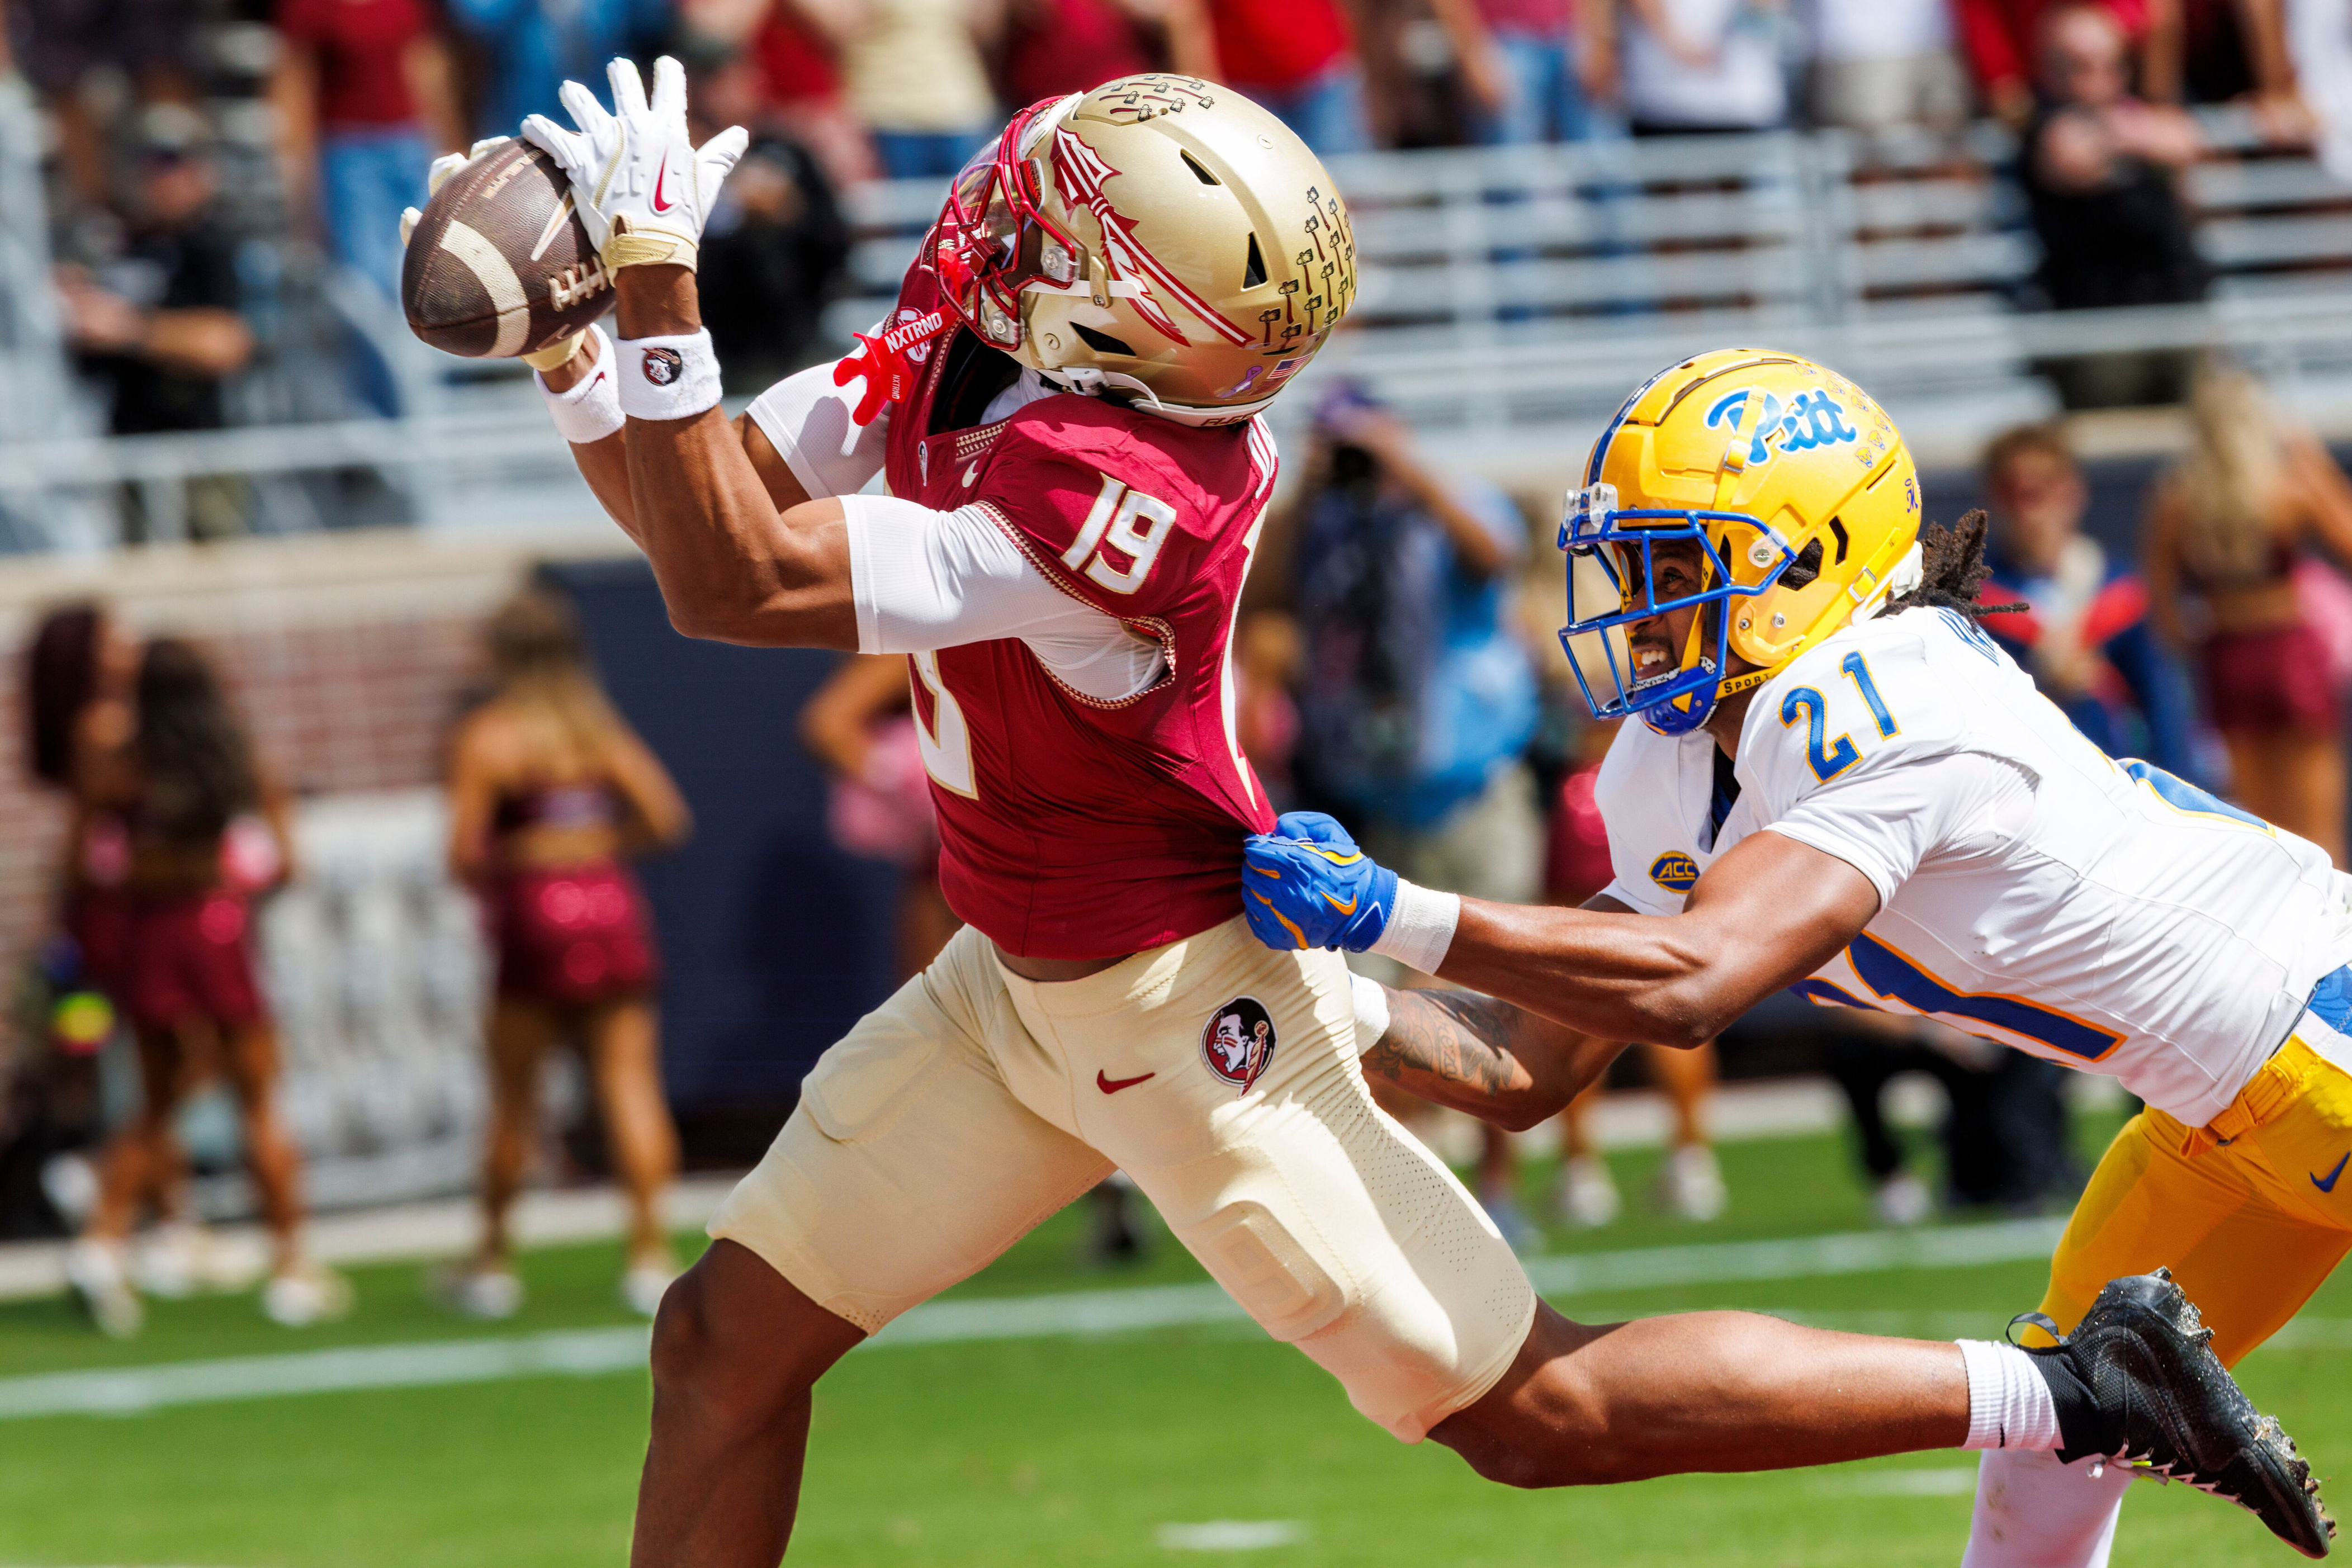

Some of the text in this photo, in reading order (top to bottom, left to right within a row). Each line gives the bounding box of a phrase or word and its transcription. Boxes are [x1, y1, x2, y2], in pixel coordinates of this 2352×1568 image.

[884, 311, 943, 354] NXTRND
[891, 373, 901, 400] NXTRND
[1703, 386, 1859, 466] Pitt
[1059, 471, 1177, 595] 19
[1778, 648, 1901, 785] 21
[1658, 861, 1696, 878] ACC
